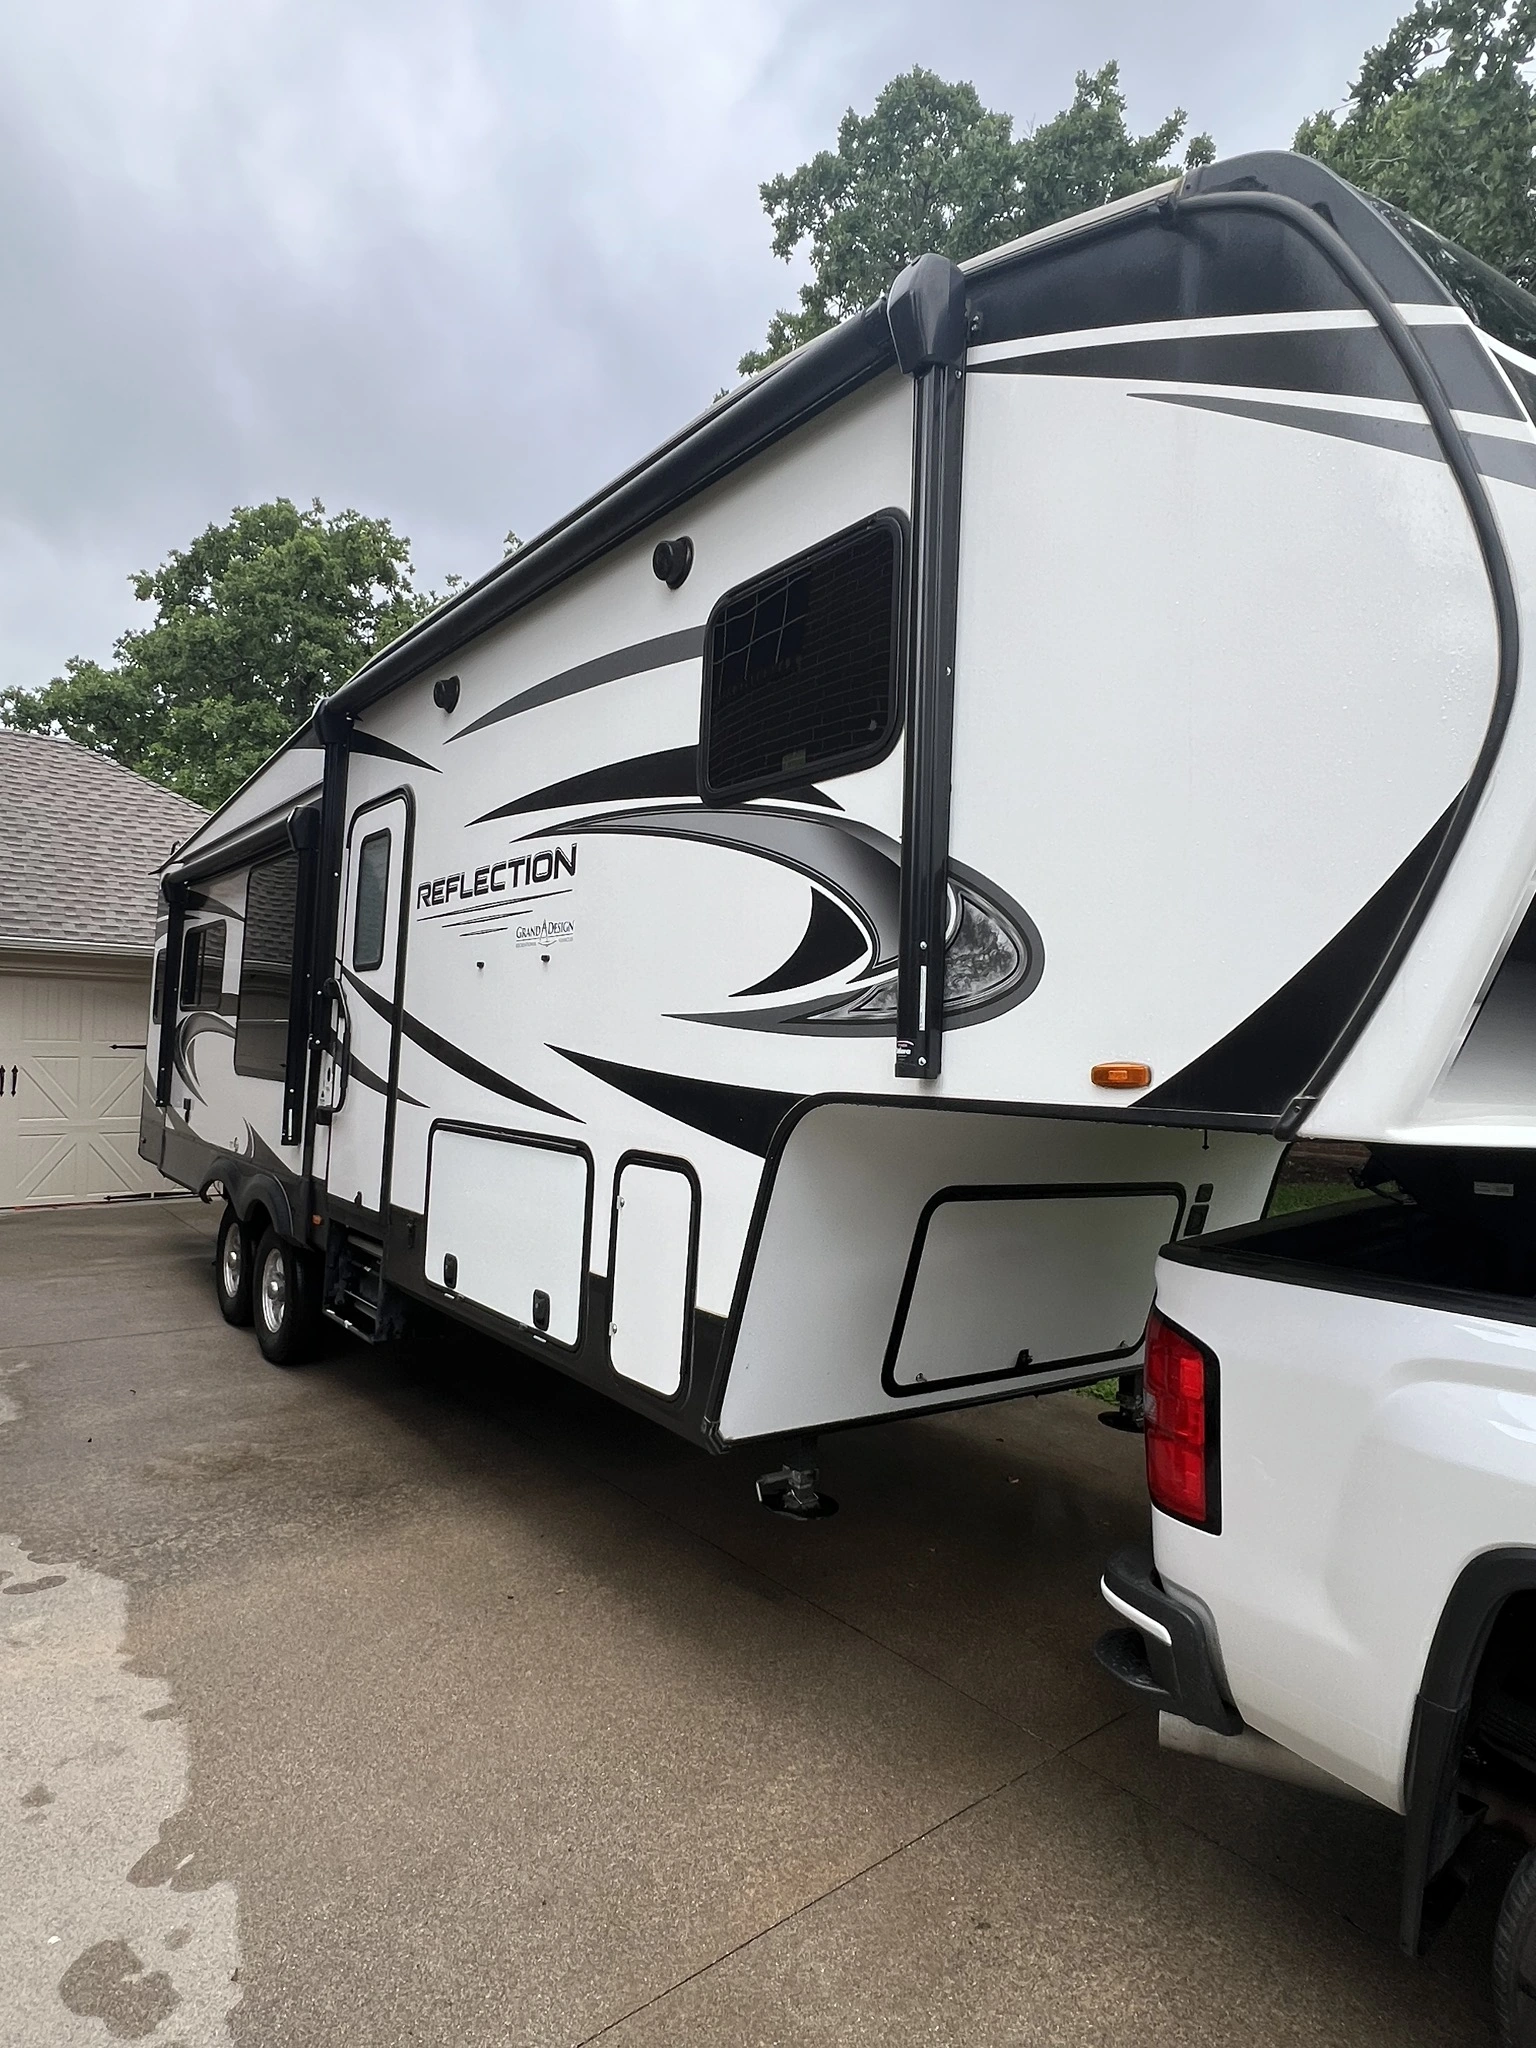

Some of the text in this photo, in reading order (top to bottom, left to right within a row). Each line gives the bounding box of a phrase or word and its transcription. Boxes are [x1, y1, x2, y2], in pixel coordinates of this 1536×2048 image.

[416, 842, 577, 910] REFLECTION
[516, 920, 575, 939] GRAND DESIGN
